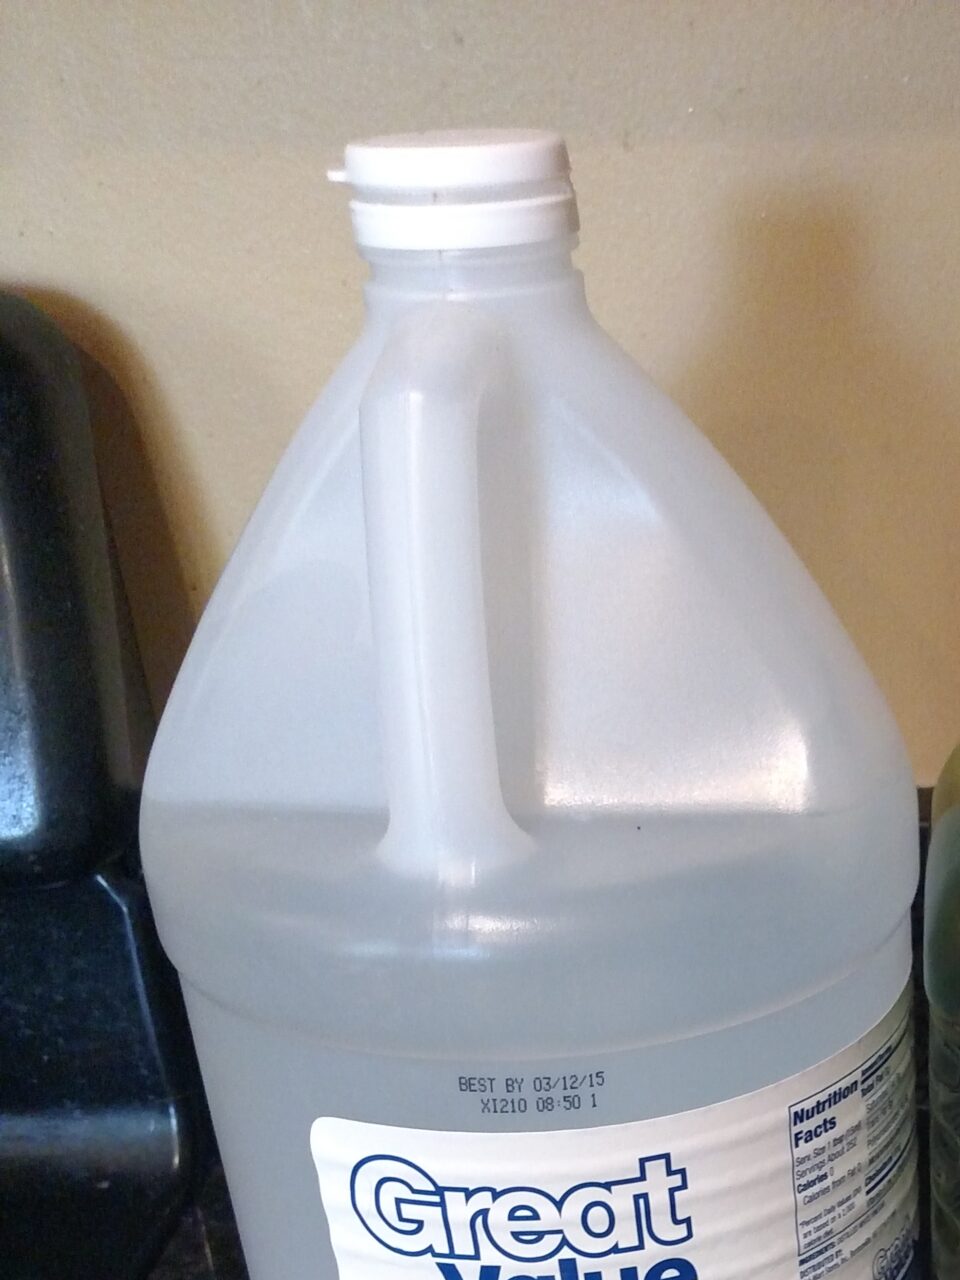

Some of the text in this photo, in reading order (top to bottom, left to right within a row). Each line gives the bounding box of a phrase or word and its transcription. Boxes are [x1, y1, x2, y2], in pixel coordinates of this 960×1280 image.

[458, 1071, 605, 1093] BEST BY 03/12/15
[536, 1094, 581, 1112] 08:50
[591, 1093, 597, 1108] 1
[793, 1080, 858, 1126] Nutrition
[794, 1116, 836, 1149] Facts
[797, 1172, 828, 1194] Calories
[350, 1152, 694, 1263] Great
